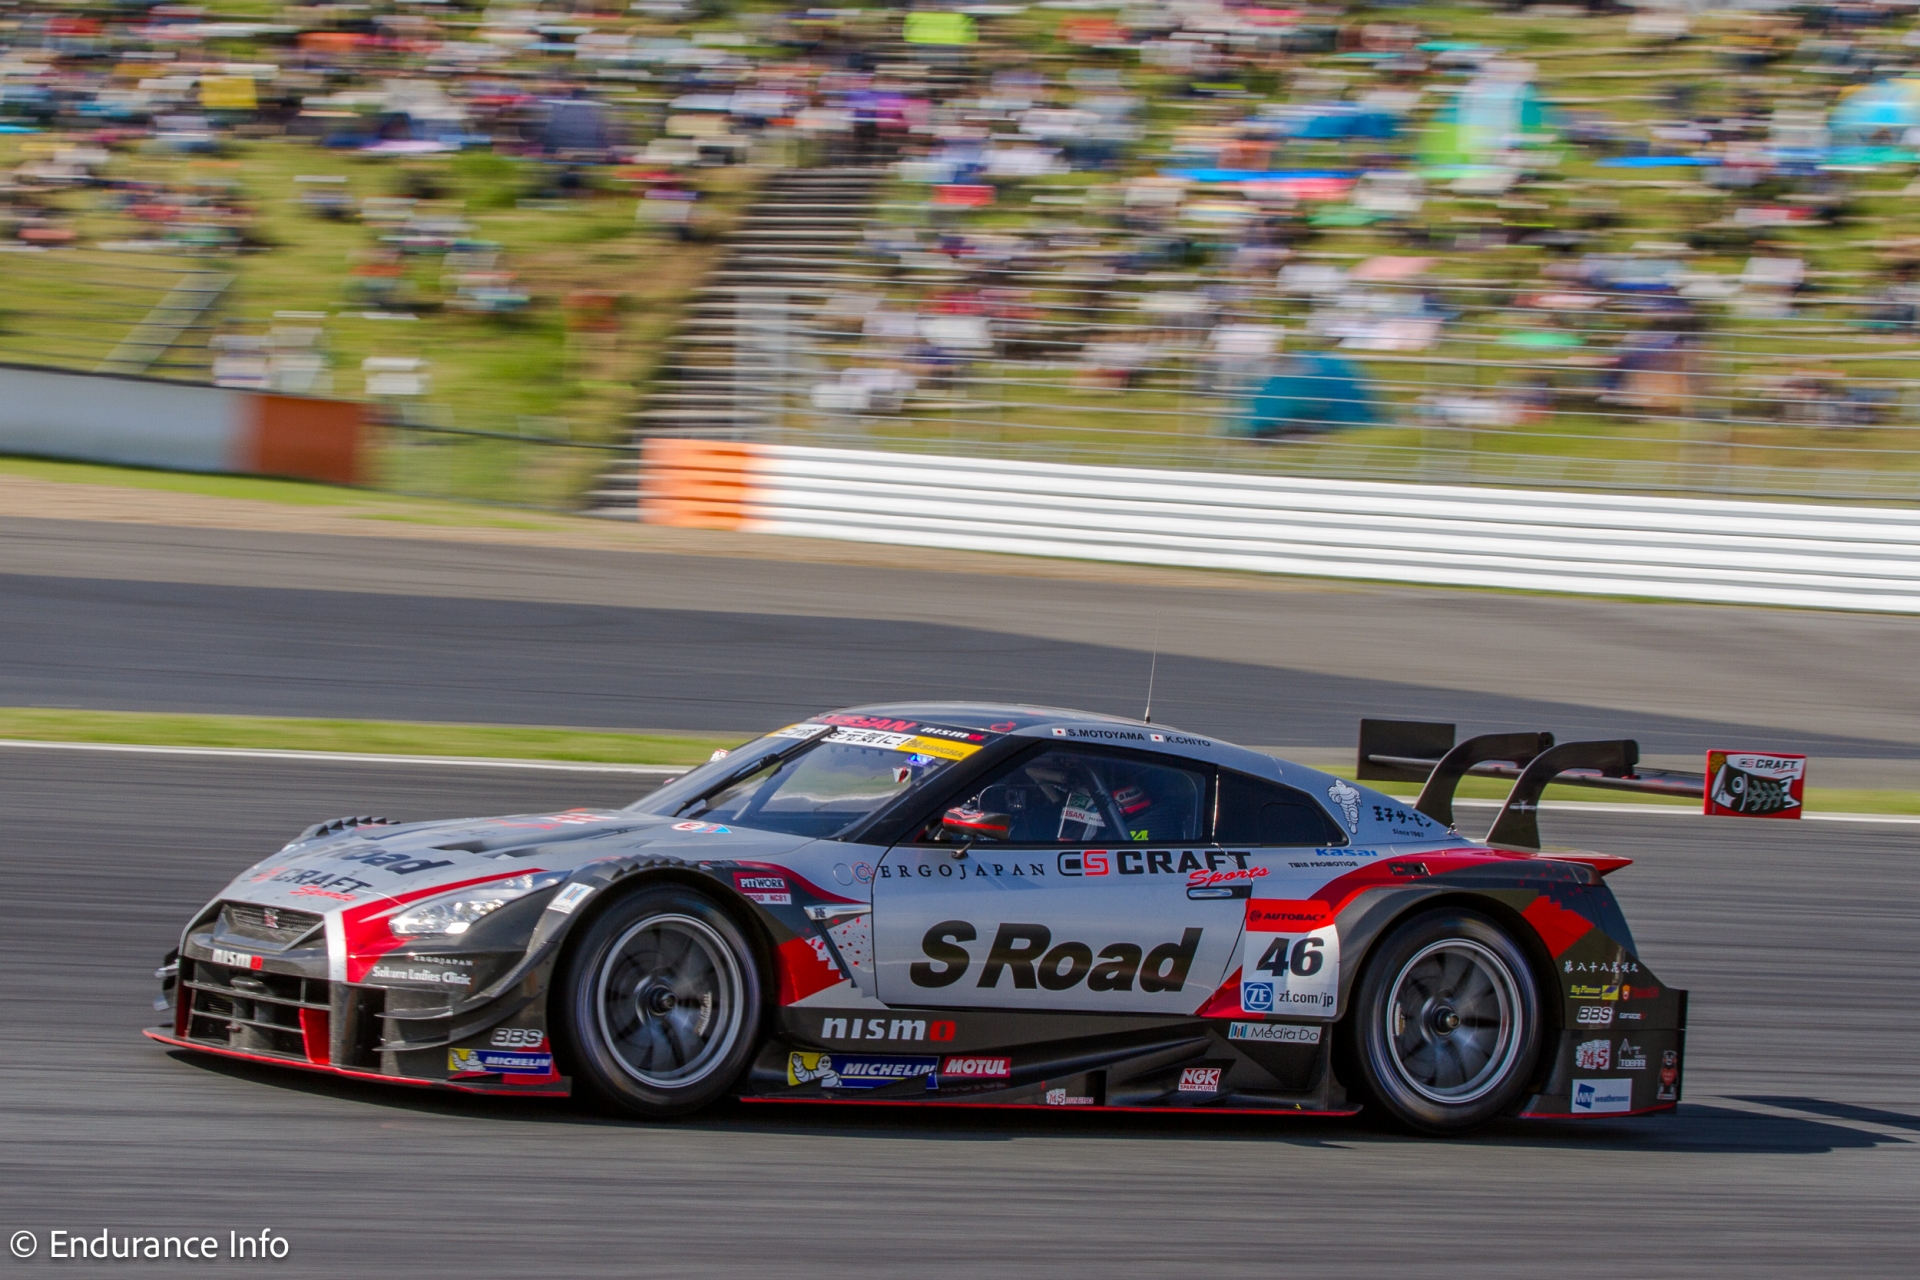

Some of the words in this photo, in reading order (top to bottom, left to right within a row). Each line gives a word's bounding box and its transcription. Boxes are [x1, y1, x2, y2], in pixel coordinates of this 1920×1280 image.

[920, 727, 984, 741] nismo
[1068, 728, 1146, 741] S.MOTOYAMA
[1165, 736, 1211, 747] K.CHIYO
[1755, 759, 1798, 769] CRAFT
[1372, 805, 1432, 828] 王子サーモン
[1315, 848, 1378, 856] kasai
[1115, 850, 1252, 875] CRAFT
[881, 862, 1046, 880] ERGOJAPAN
[1186, 866, 1271, 887] Sports
[740, 878, 785, 889] PITWORK
[212, 949, 263, 970] nismo
[910, 920, 977, 989] S
[976, 922, 1204, 994] Road
[1256, 937, 1324, 977] 46
[372, 966, 408, 979] Sakura
[408, 968, 441, 982] Ladies
[1250, 988, 1268, 1001] ZF
[1279, 991, 1334, 1008] zf.com/jp
[1577, 1006, 1613, 1023] BBS
[821, 1017, 956, 1041] nismo
[490, 1028, 543, 1048] BBS
[485, 1056, 551, 1067] MICHELIN
[842, 1062, 935, 1076] MICHELIN
[945, 1059, 1007, 1075] MOTUL
[1181, 1069, 1219, 1085] NGK
